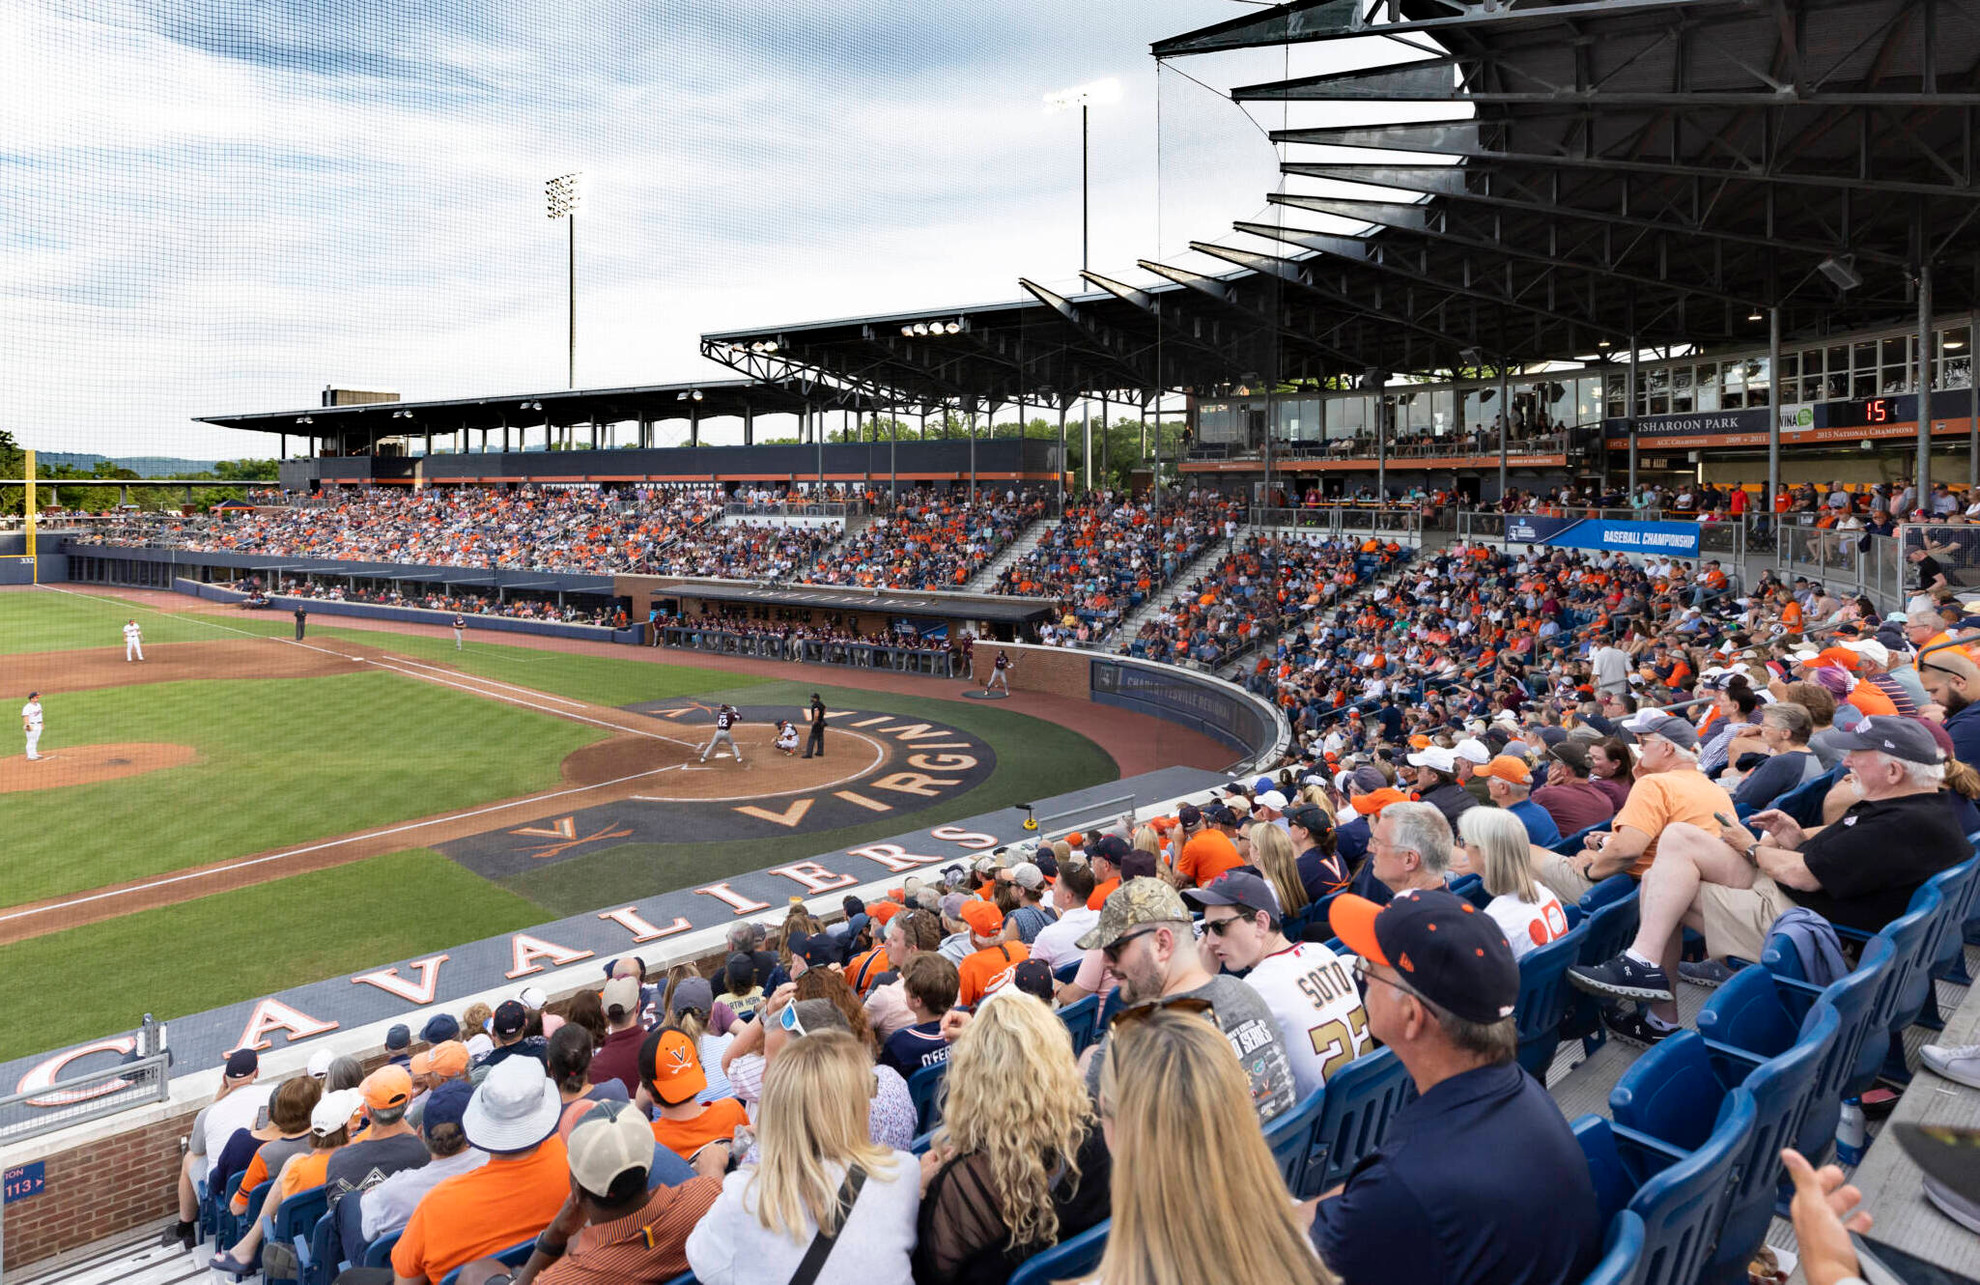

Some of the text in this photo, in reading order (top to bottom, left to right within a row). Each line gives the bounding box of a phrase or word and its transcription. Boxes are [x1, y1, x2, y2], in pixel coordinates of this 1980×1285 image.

[1867, 400, 1887, 422] 15
[1705, 417, 1740, 430] PARK
[1816, 430, 1832, 440] 2015
[1603, 530, 1696, 549] BASEBALL CHAMPIONSHIP
[16, 826, 999, 1106] CAVALIERS
[1297, 960, 1353, 1010] SOTO
[727, 999, 744, 1010] RTIN
[1238, 1019, 1274, 1055] SERIES
[6, 1179, 32, 1198] 113
